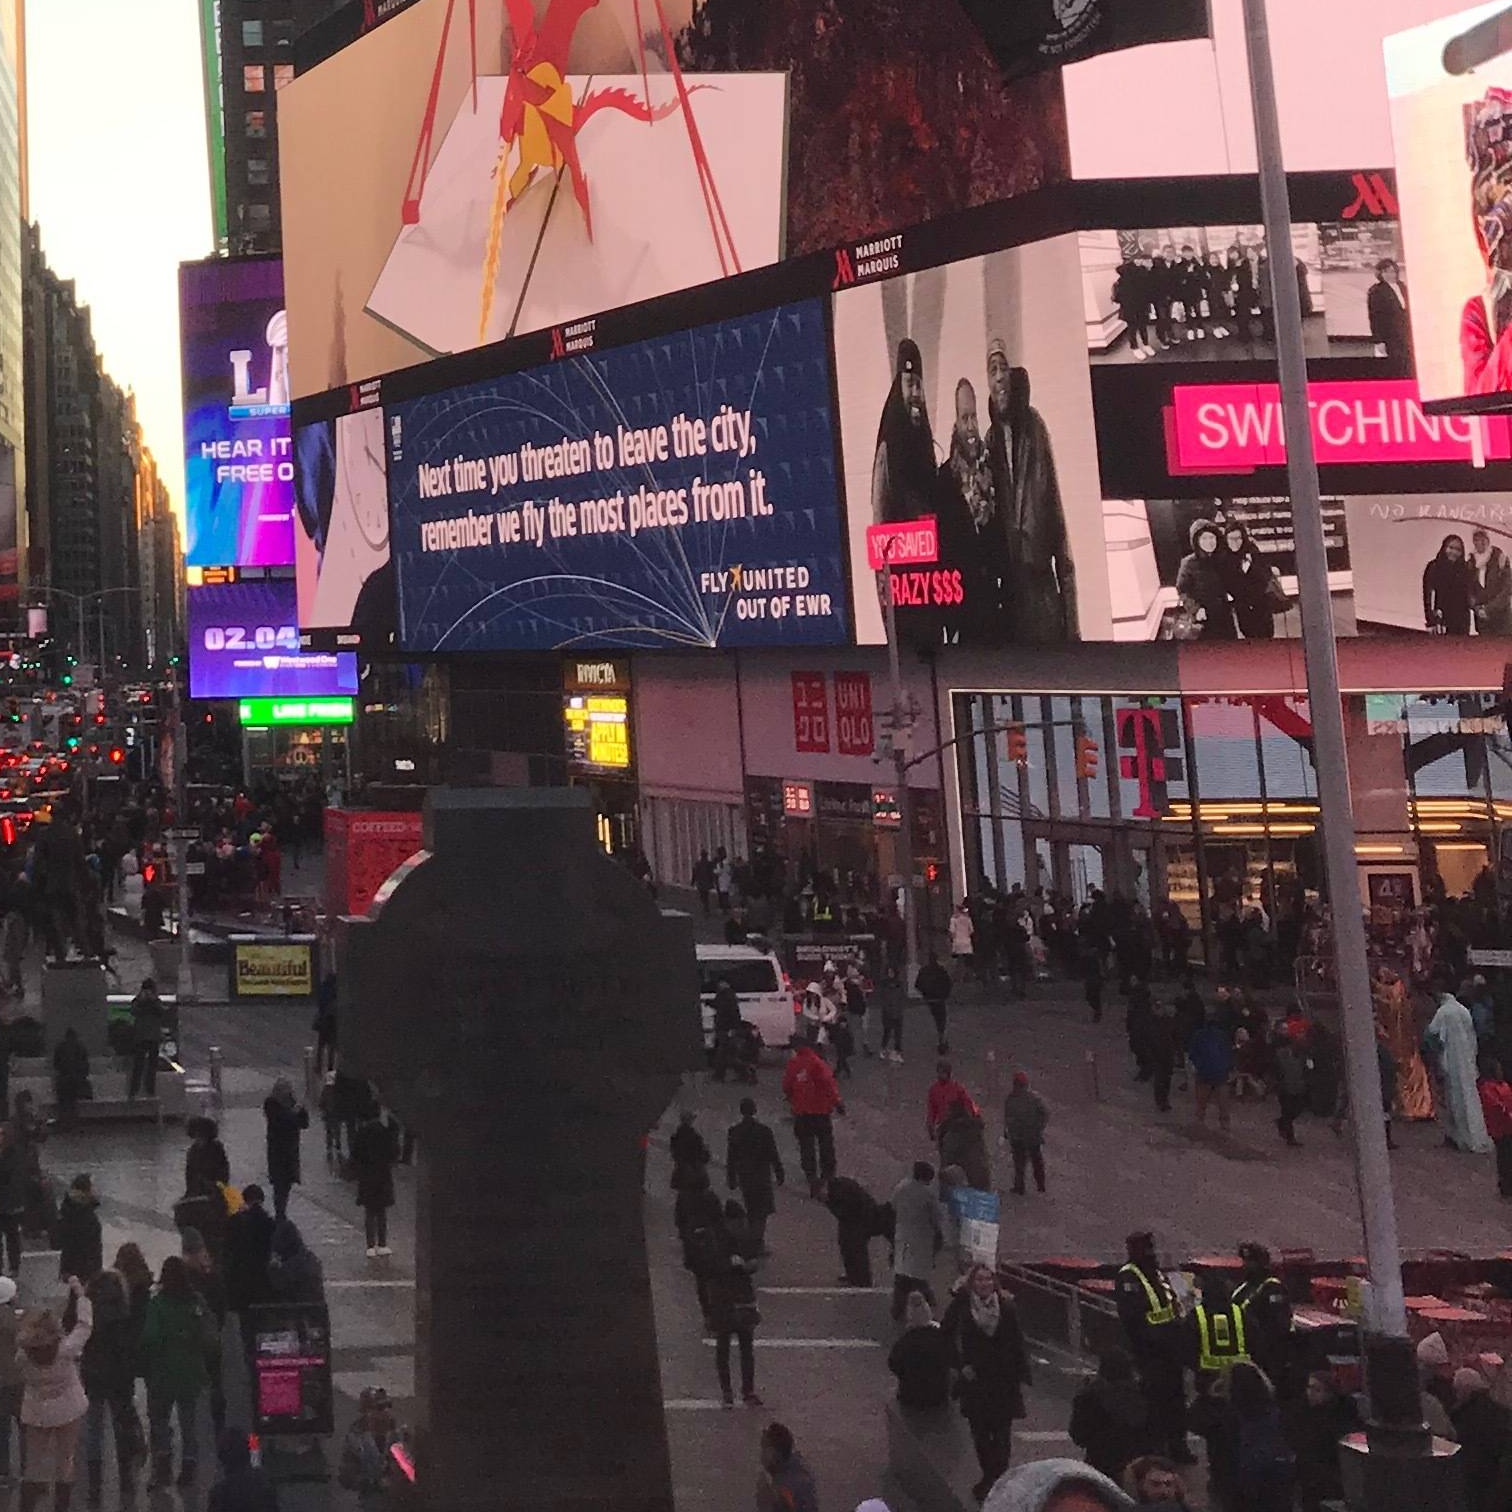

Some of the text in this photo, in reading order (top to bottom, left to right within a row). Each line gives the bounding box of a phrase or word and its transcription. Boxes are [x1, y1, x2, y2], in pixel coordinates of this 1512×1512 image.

[856, 235, 903, 259] MARRIOTT
[858, 255, 899, 276] MARQUIS
[249, 406, 288, 416] SUPER
[201, 437, 292, 459] HEAR IT
[418, 404, 756, 499] Next time you threaten to leave the city,
[216, 463, 274, 483] FREE
[421, 467, 774, 552] remember we fly the most places from it.
[897, 530, 935, 558] SAVED
[700, 566, 809, 593] FLY UNITED
[889, 569, 963, 606] RAZY $$$
[736, 593, 831, 620] OUT OF EWR
[576, 662, 616, 684] INVICTA
[840, 716, 871, 749] QLO
[239, 960, 307, 977] Beautiful
